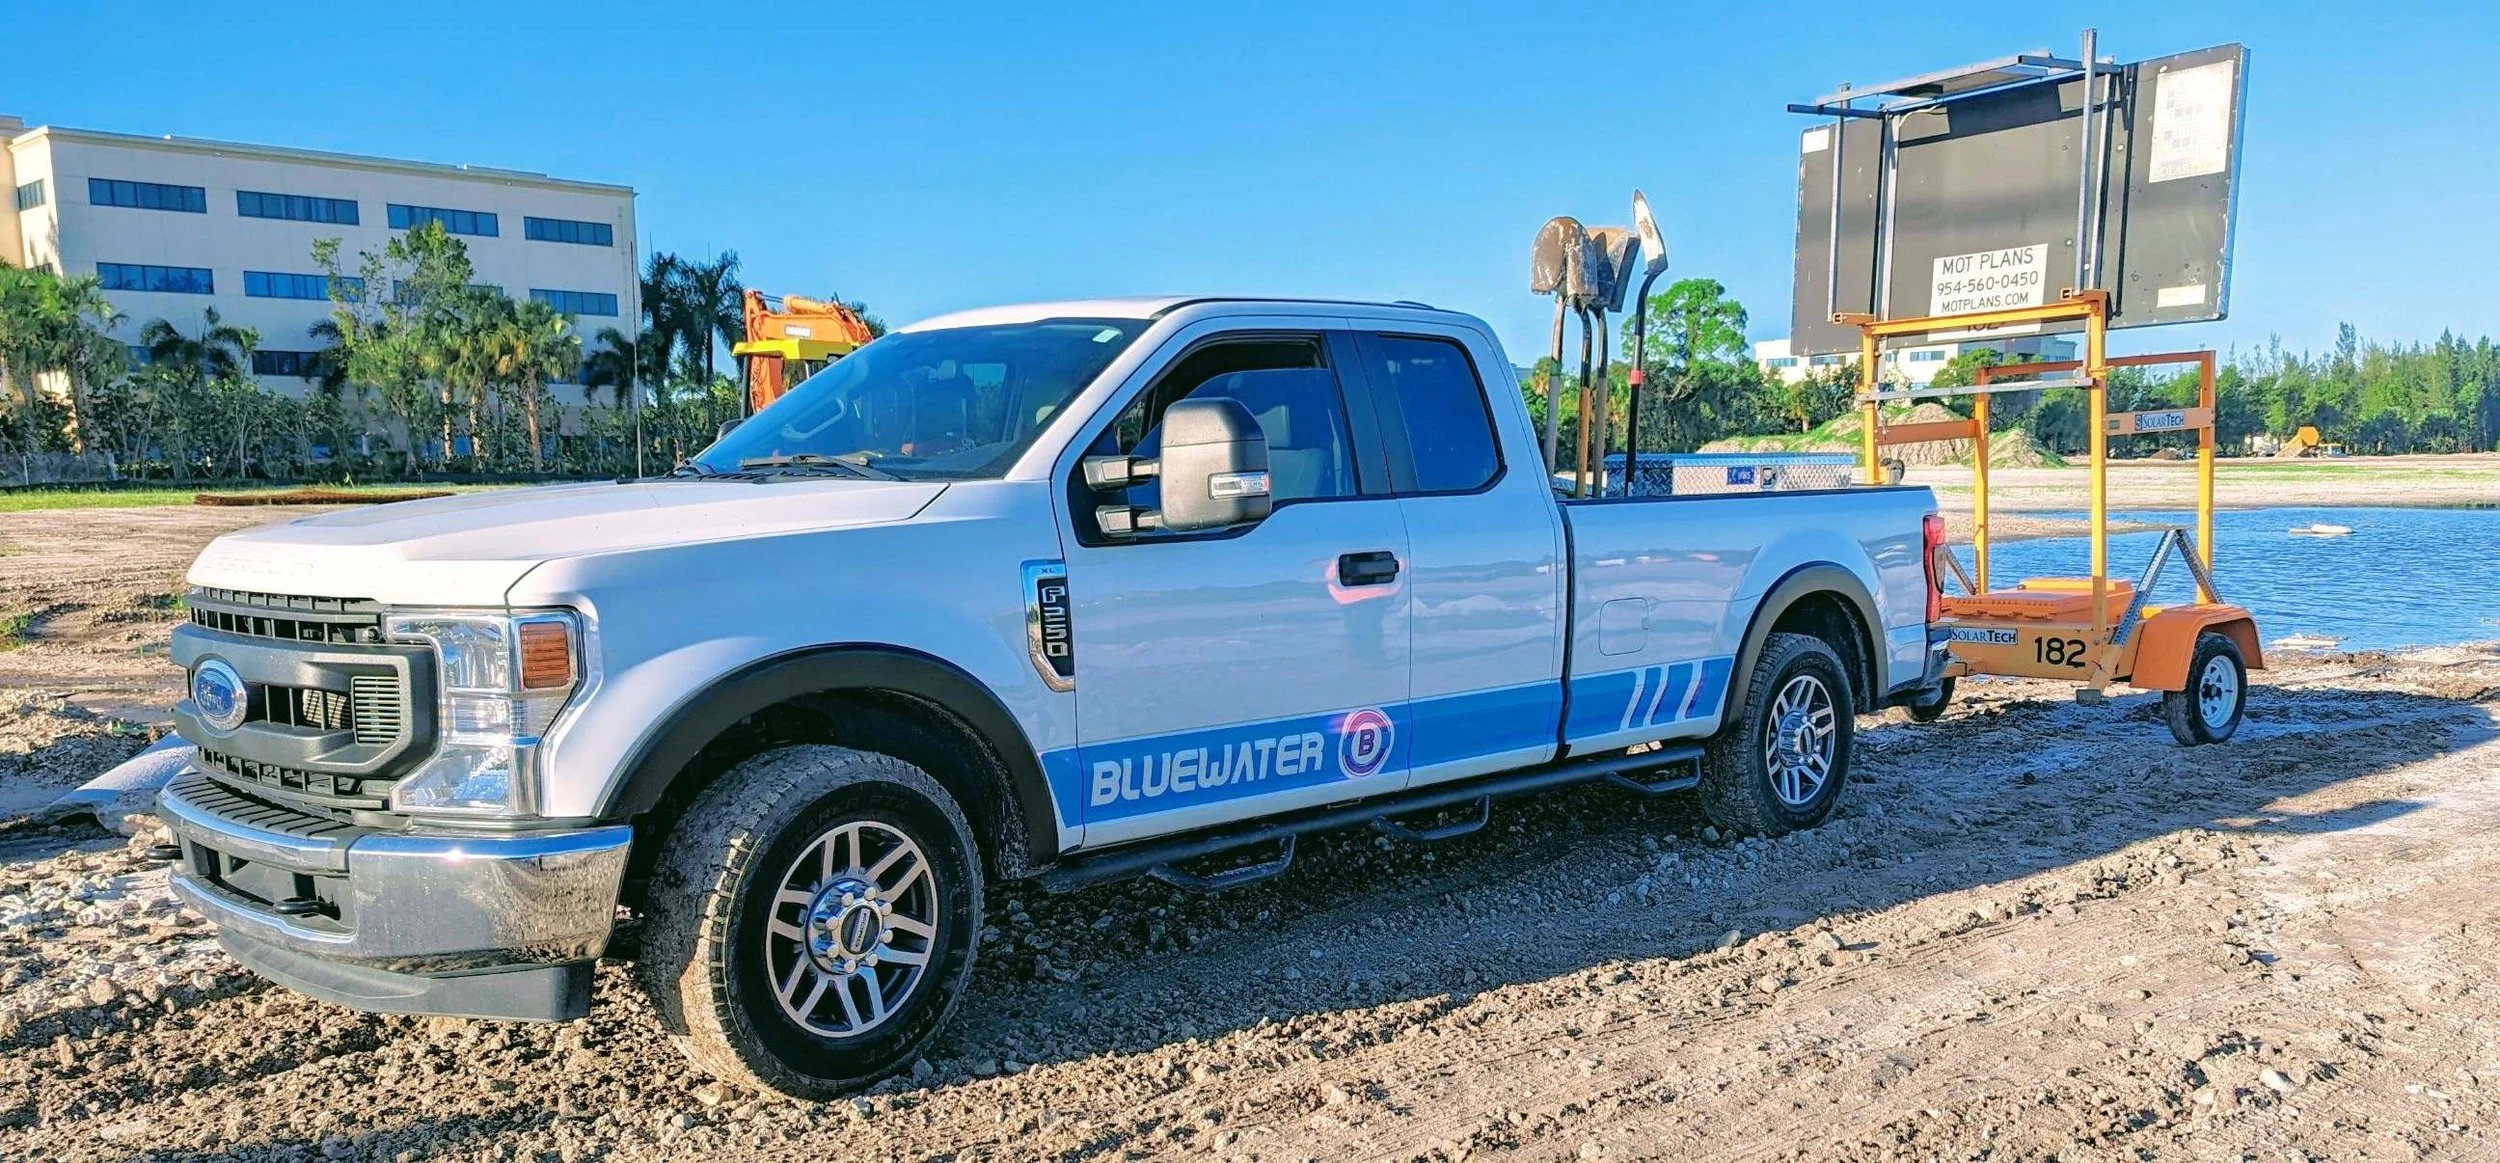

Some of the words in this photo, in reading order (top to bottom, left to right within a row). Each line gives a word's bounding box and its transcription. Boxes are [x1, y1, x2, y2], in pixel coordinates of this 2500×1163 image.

[1942, 256, 1974, 275] MOT
[1980, 247, 2034, 270] PLANS
[1937, 270, 2039, 296] 954-560-0450
[1941, 292, 2029, 313] MOTPLANS.COM
[2034, 636, 2087, 668] 182
[1090, 732, 1325, 807] BLUEWATER
